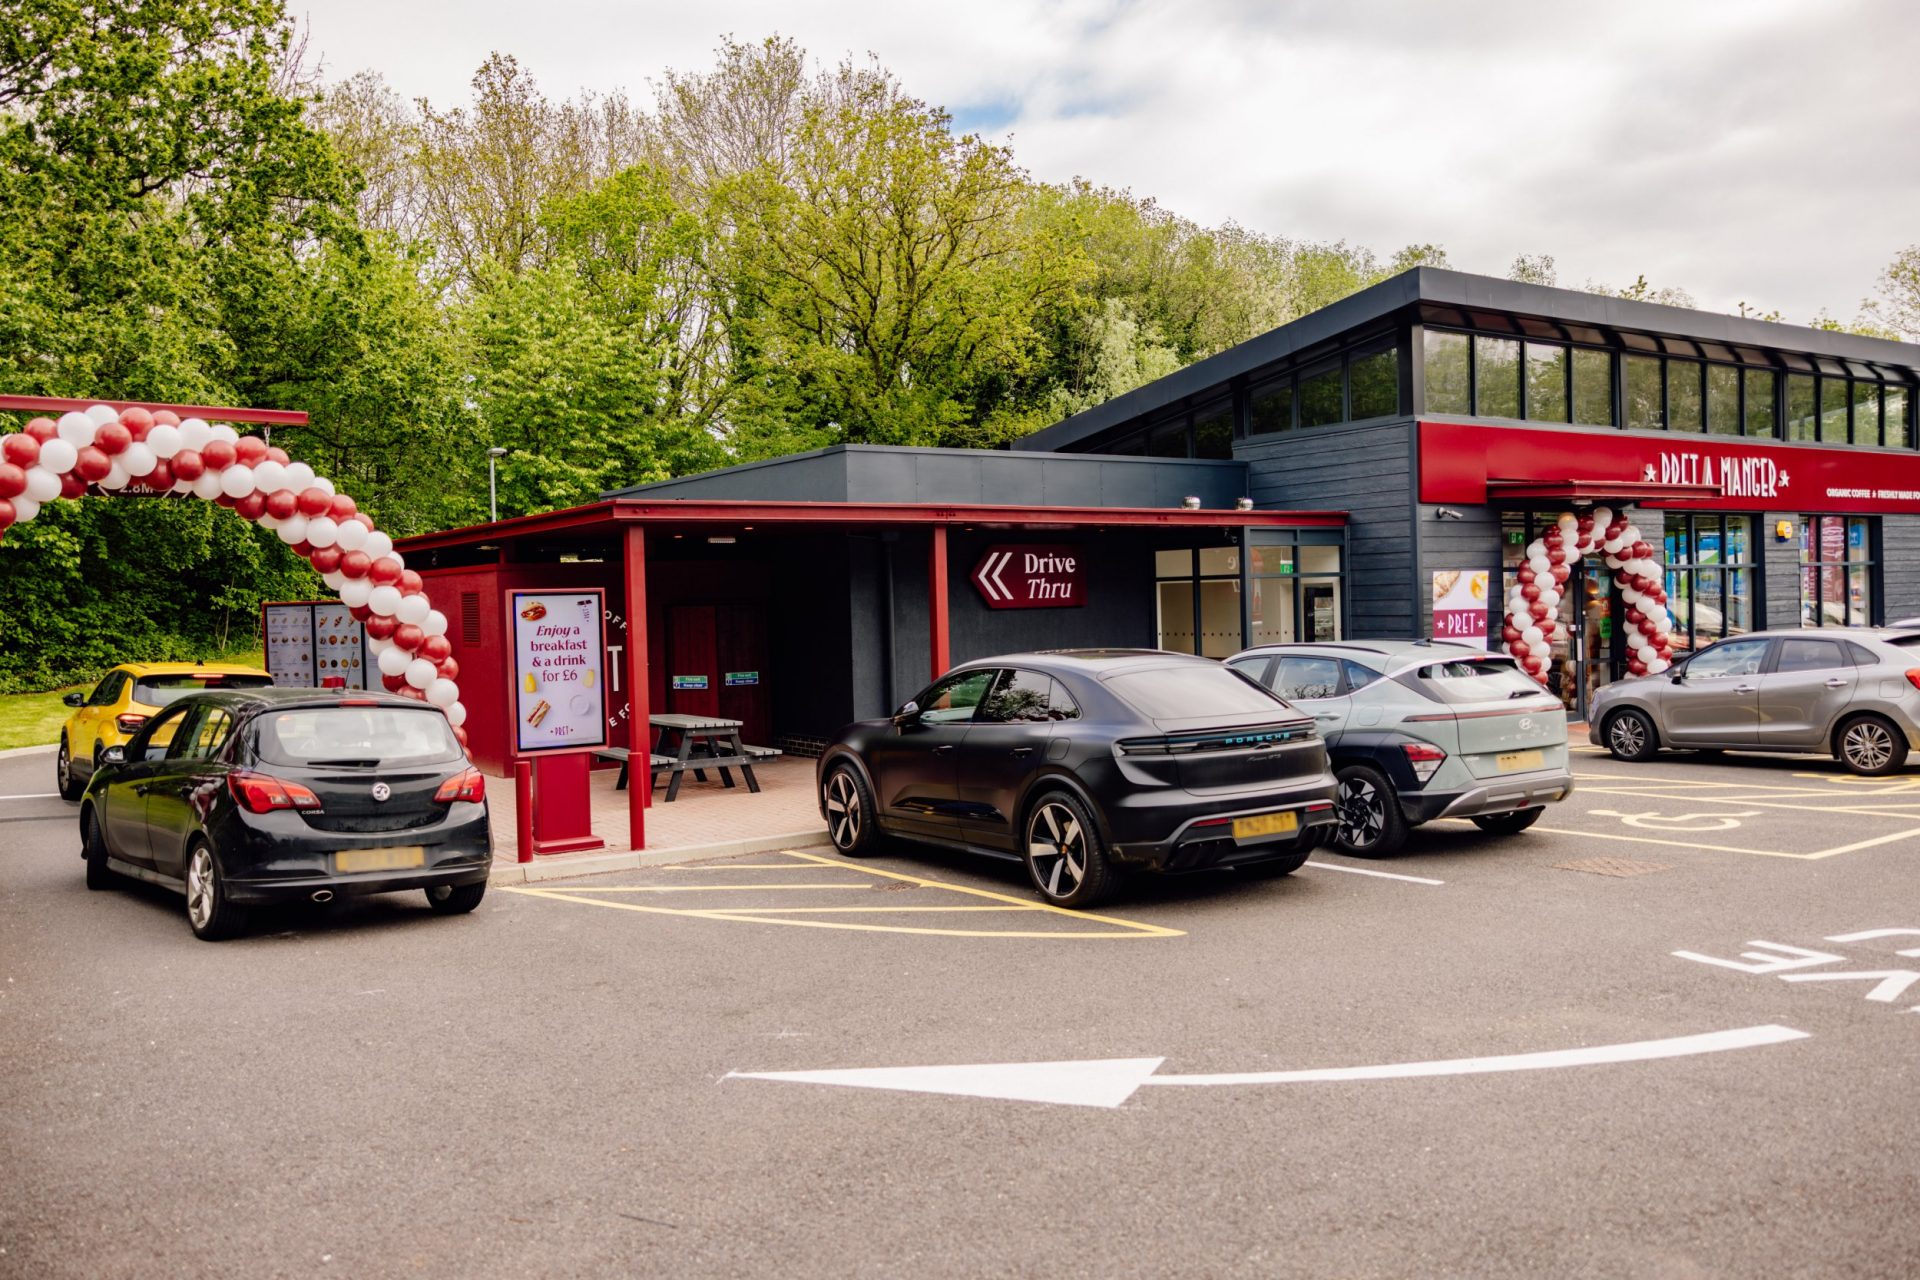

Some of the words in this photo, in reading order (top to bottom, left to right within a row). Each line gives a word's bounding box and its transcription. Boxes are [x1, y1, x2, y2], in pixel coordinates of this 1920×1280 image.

[1720, 456, 1777, 497] MANGER
[1826, 488, 1851, 498] ORGANIC
[1851, 488, 1870, 498] COFFEE
[1877, 489, 1897, 499] FRESHLY
[1898, 490, 1912, 500] MADE
[1024, 552, 1076, 574] Drive
[1027, 578, 1072, 599] Thru
[1448, 612, 1476, 634] PRET
[536, 625, 571, 638] Enjoy
[573, 626, 580, 635] a
[530, 640, 587, 652] breakfast
[532, 657, 541, 667] &
[544, 659, 551, 667] a
[554, 655, 586, 666] drink
[543, 670, 560, 682] for
[563, 669, 577, 681] £6
[1226, 732, 1290, 745] PORSCHE
